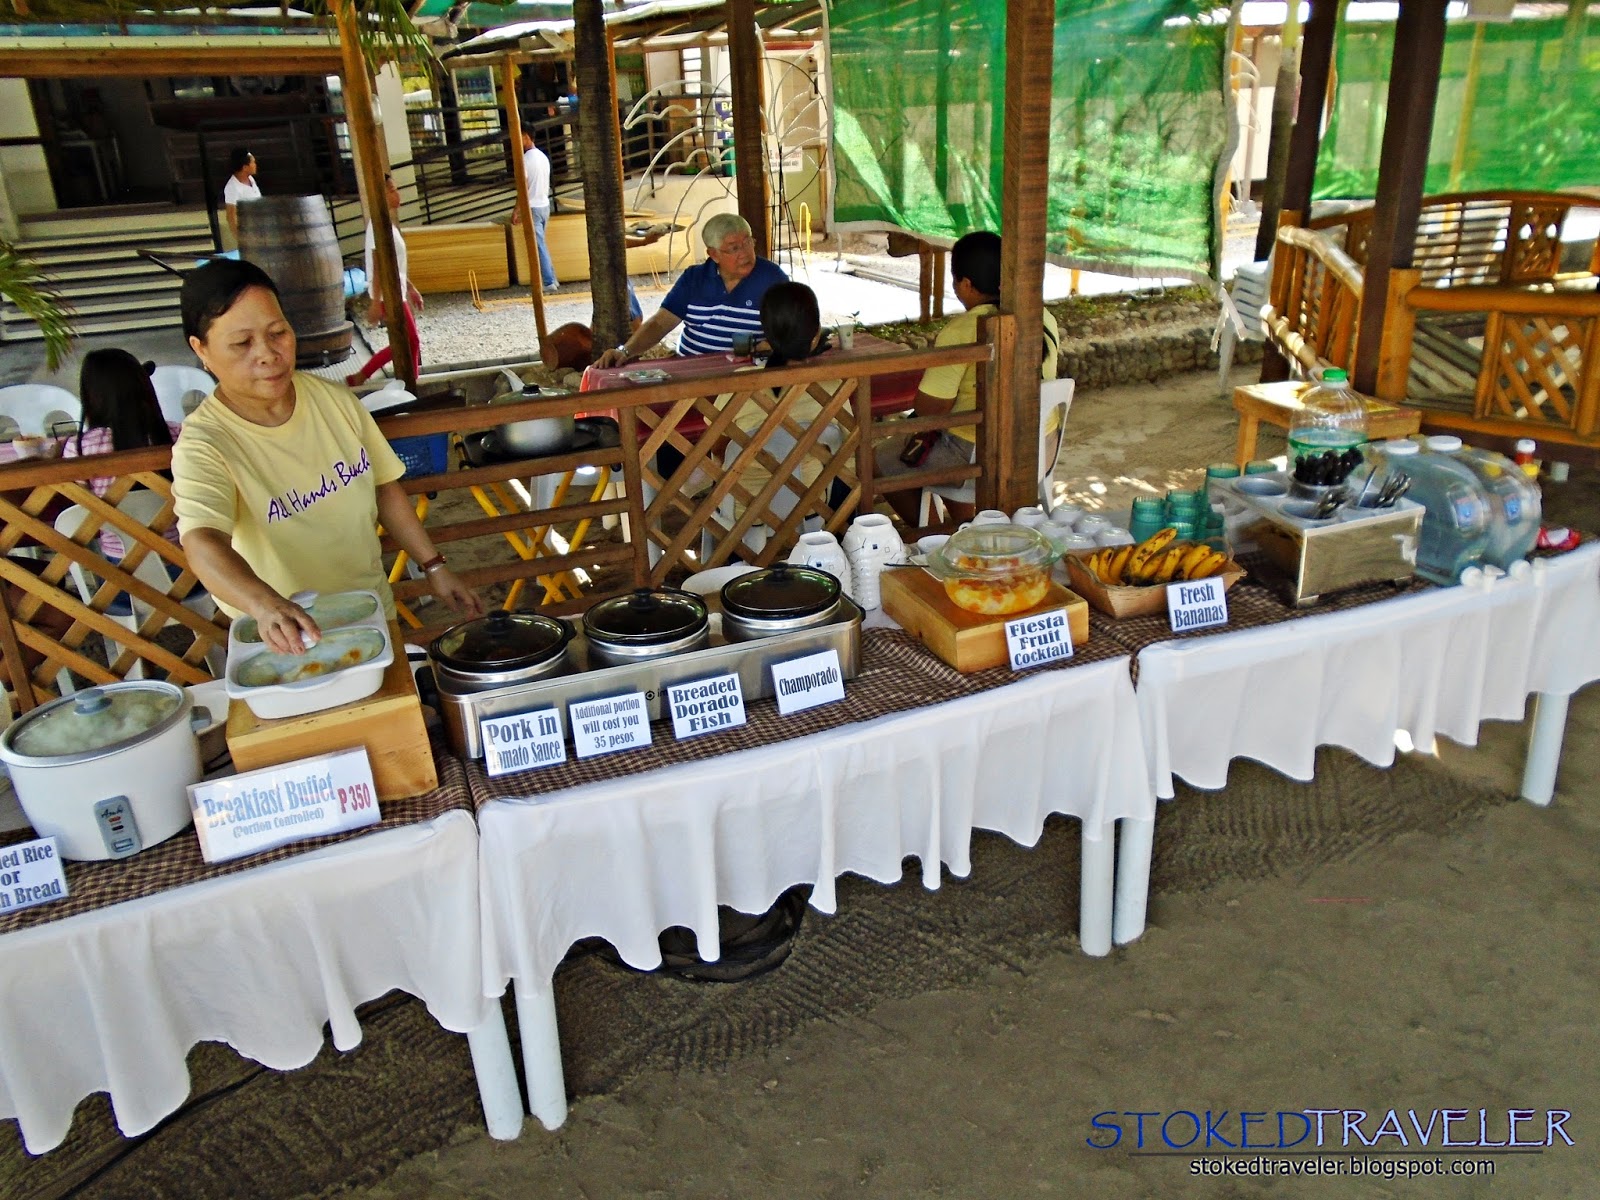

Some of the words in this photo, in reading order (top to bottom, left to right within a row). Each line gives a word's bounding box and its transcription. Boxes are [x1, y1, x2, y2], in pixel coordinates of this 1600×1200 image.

[286, 474, 338, 512] Hands
[1179, 582, 1215, 605] Fresh
[1009, 616, 1065, 638] Fiesta
[1174, 604, 1225, 628] Bananas
[1019, 629, 1061, 650] Fruit
[1014, 642, 1070, 666] Cocktail
[672, 678, 737, 703] Breaded
[779, 666, 838, 697] Champorado
[575, 702, 612, 720] Additional
[613, 698, 640, 714] portion
[675, 695, 739, 719] Dorado
[486, 718, 534, 745] Pork
[538, 715, 558, 736] in
[583, 719, 600, 734] will
[602, 716, 620, 731] cost
[622, 714, 639, 729] you
[689, 712, 732, 732] Fish
[594, 735, 606, 748] 35
[609, 731, 635, 748] pesos
[489, 745, 530, 771] omato
[531, 740, 562, 763] Sauce
[203, 784, 285, 828] Breakfast
[284, 772, 336, 810] Buffet
[274, 807, 325, 829] Controlled)
[22, 845, 53, 864] Rice
[14, 878, 62, 904] Bread
